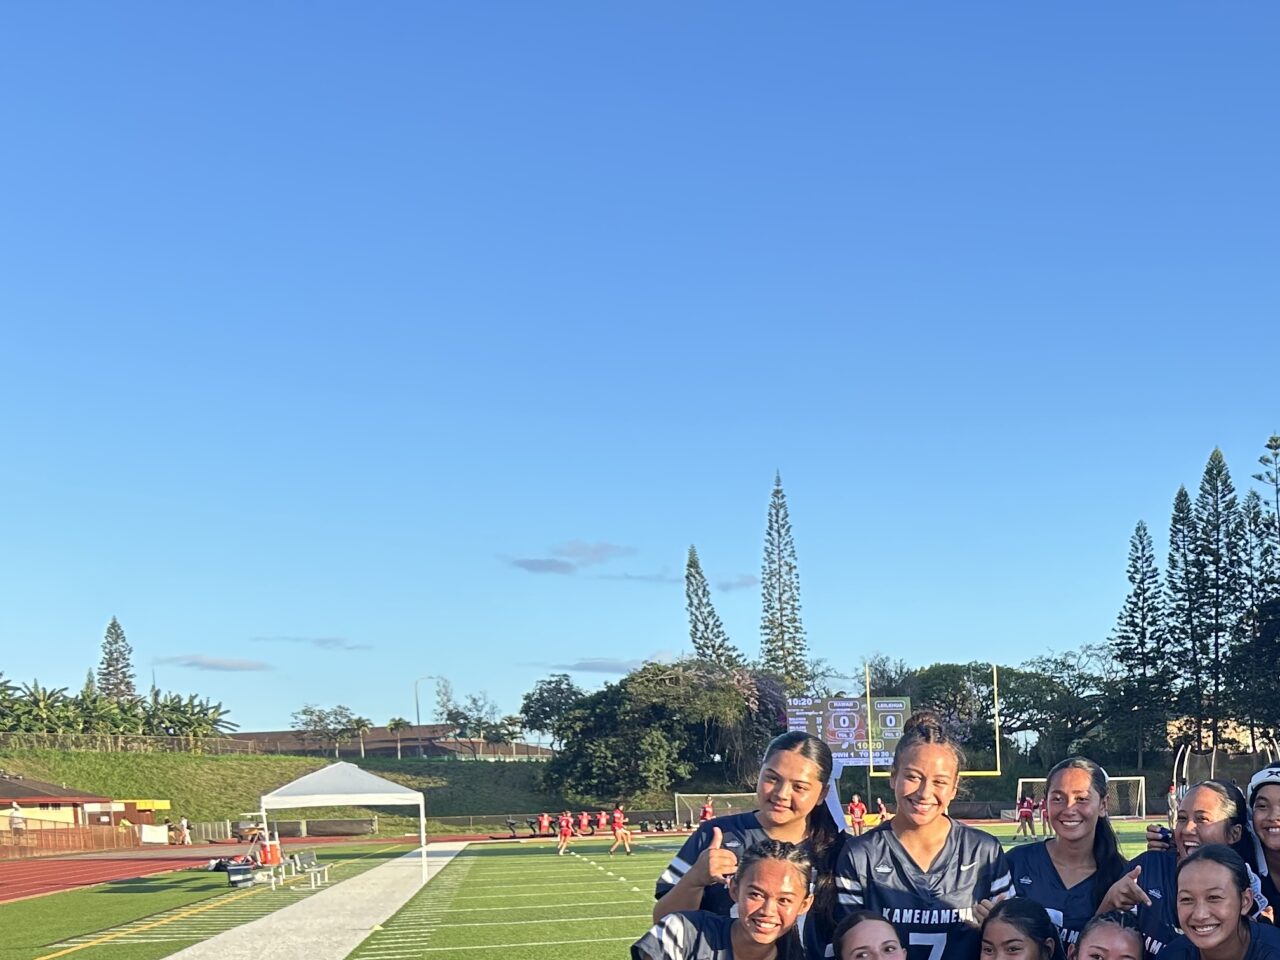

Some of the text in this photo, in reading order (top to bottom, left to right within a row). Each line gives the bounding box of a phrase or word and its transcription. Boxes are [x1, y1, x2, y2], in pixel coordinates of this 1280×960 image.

[787, 698, 812, 706] 10:20
[839, 716, 850, 727] 0
[886, 715, 896, 727] 0
